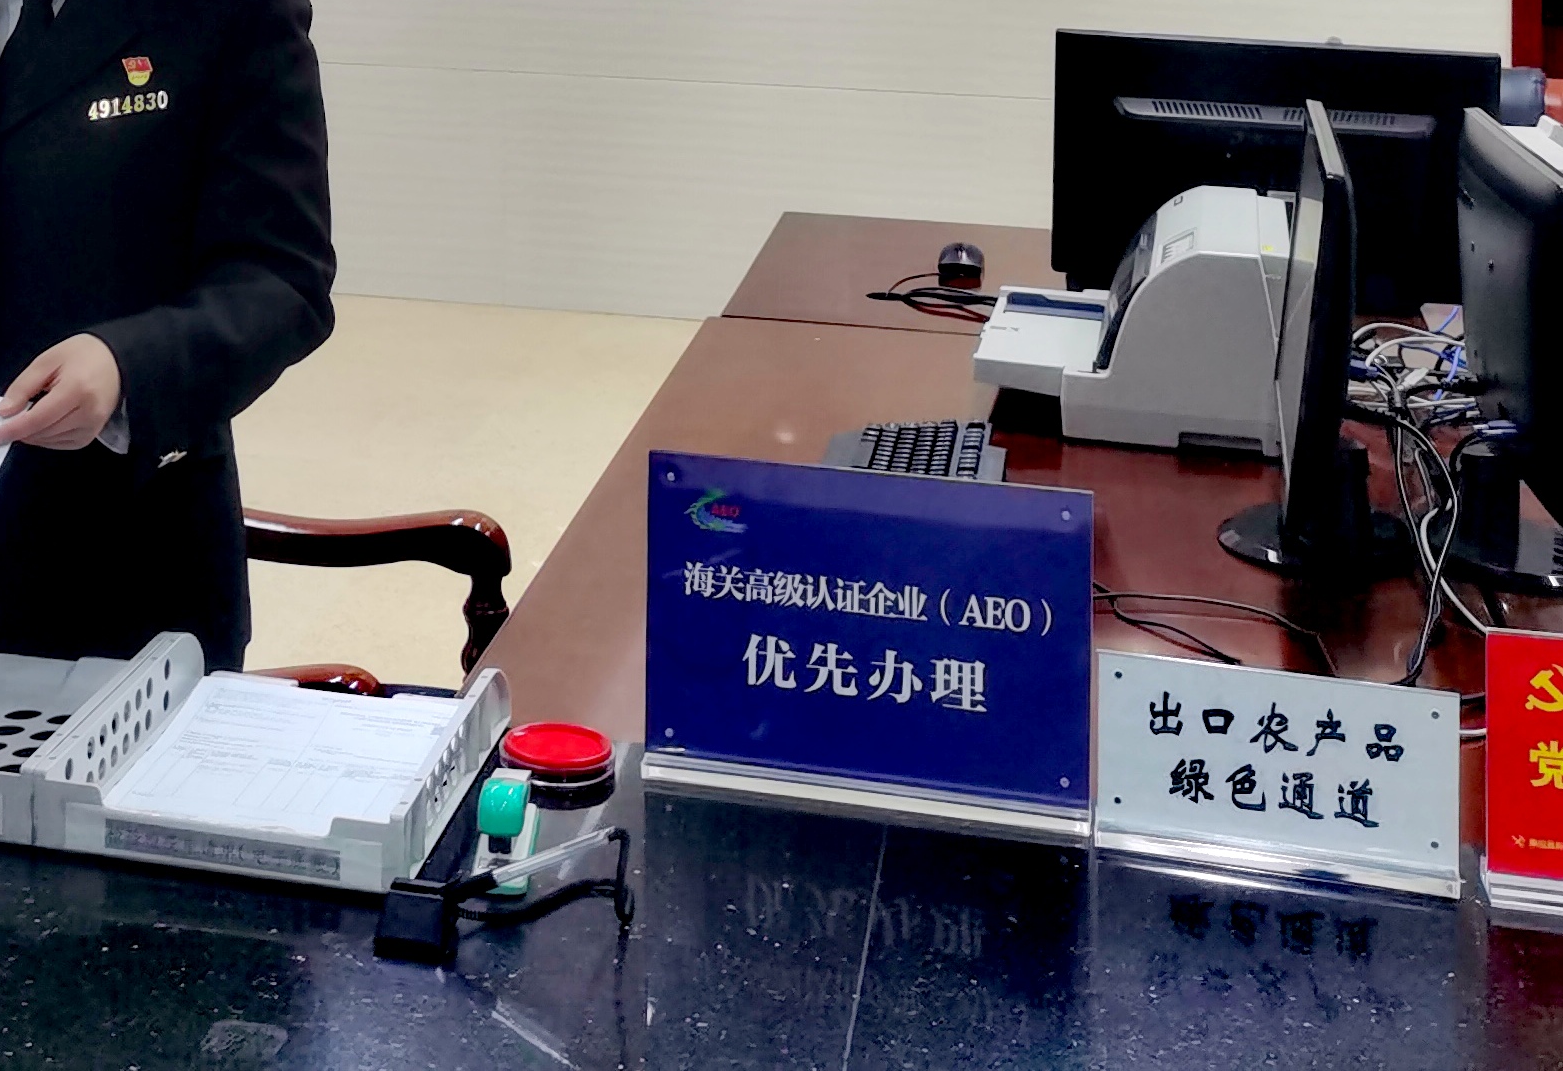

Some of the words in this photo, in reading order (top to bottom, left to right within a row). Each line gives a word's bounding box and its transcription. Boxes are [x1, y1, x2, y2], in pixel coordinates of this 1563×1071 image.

[88, 90, 169, 121] 4914830
[742, 633, 988, 712] 优先办理
[1148, 691, 1405, 762] 出口农产品
[1169, 758, 1380, 828] 绿色通道
[1529, 740, 1563, 789] 党
